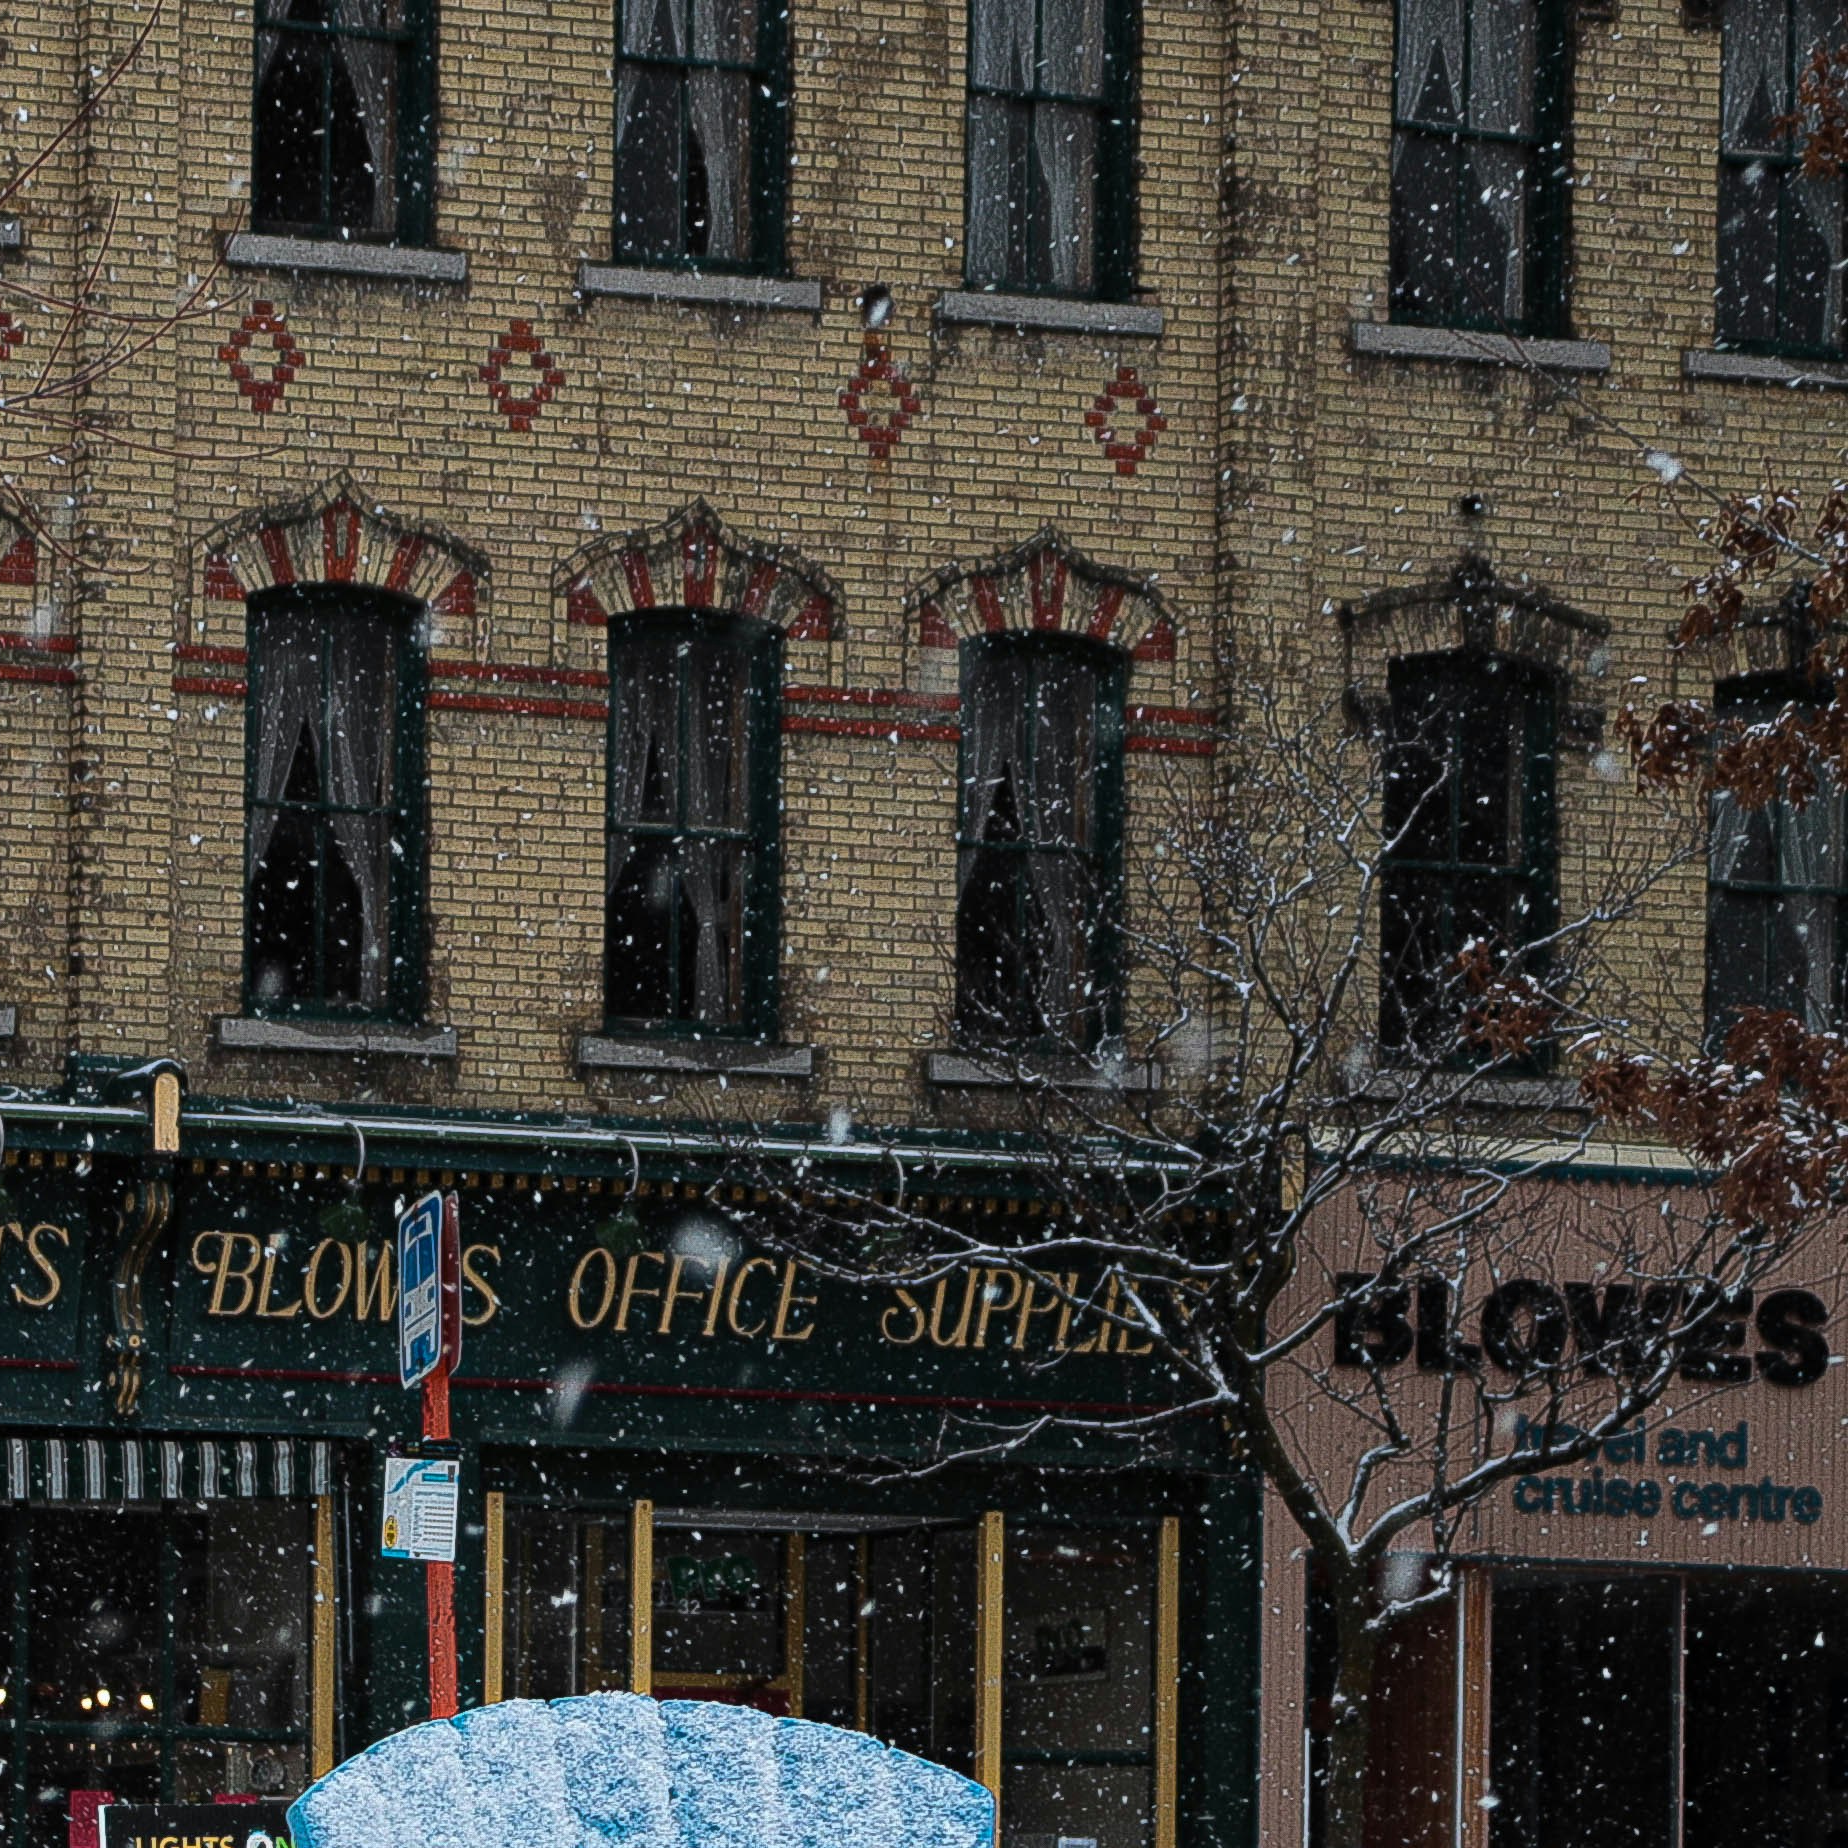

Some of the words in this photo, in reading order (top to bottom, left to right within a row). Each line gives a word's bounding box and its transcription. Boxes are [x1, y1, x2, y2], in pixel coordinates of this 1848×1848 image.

[192, 1231, 502, 1327] BLOWS
[567, 1246, 820, 1342] OFFICE
[1333, 1271, 1832, 1387] BLOWES
[1658, 1421, 1749, 1470] and
[1513, 1468, 1662, 1520] cruise
[1672, 1476, 1824, 1525] centre
